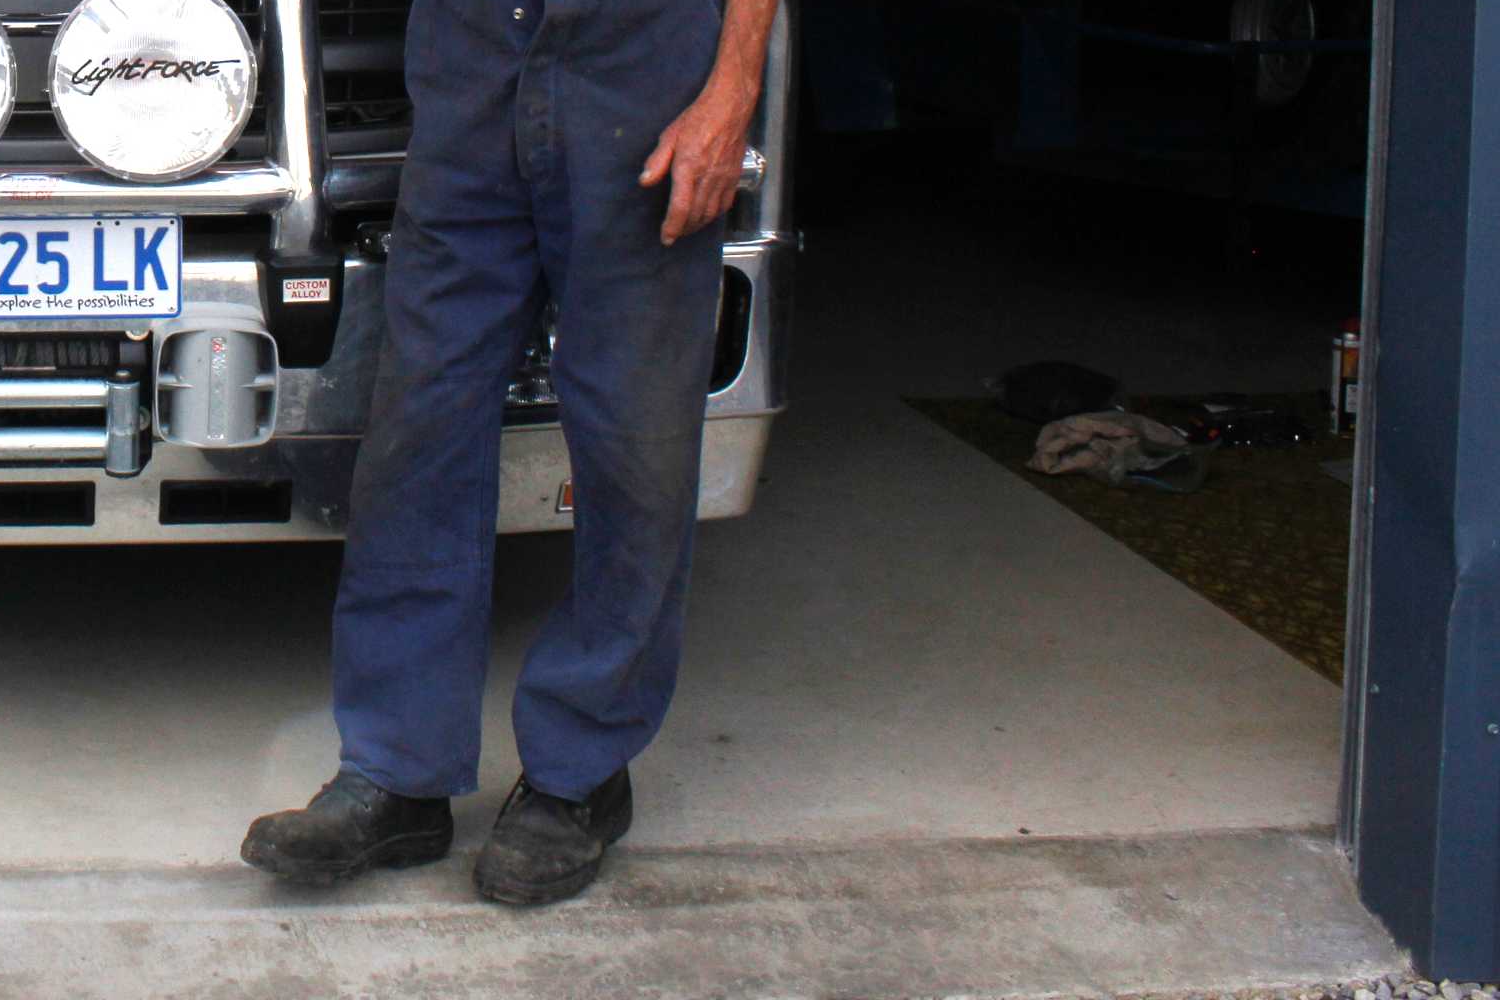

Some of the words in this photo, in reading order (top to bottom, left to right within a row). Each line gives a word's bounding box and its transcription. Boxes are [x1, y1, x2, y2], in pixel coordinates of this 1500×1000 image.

[93, 227, 169, 291] LK
[285, 281, 328, 290] CUSTOM
[291, 290, 322, 298] ALLOY
[46, 295, 73, 308] the
[77, 293, 155, 309] possibilities
